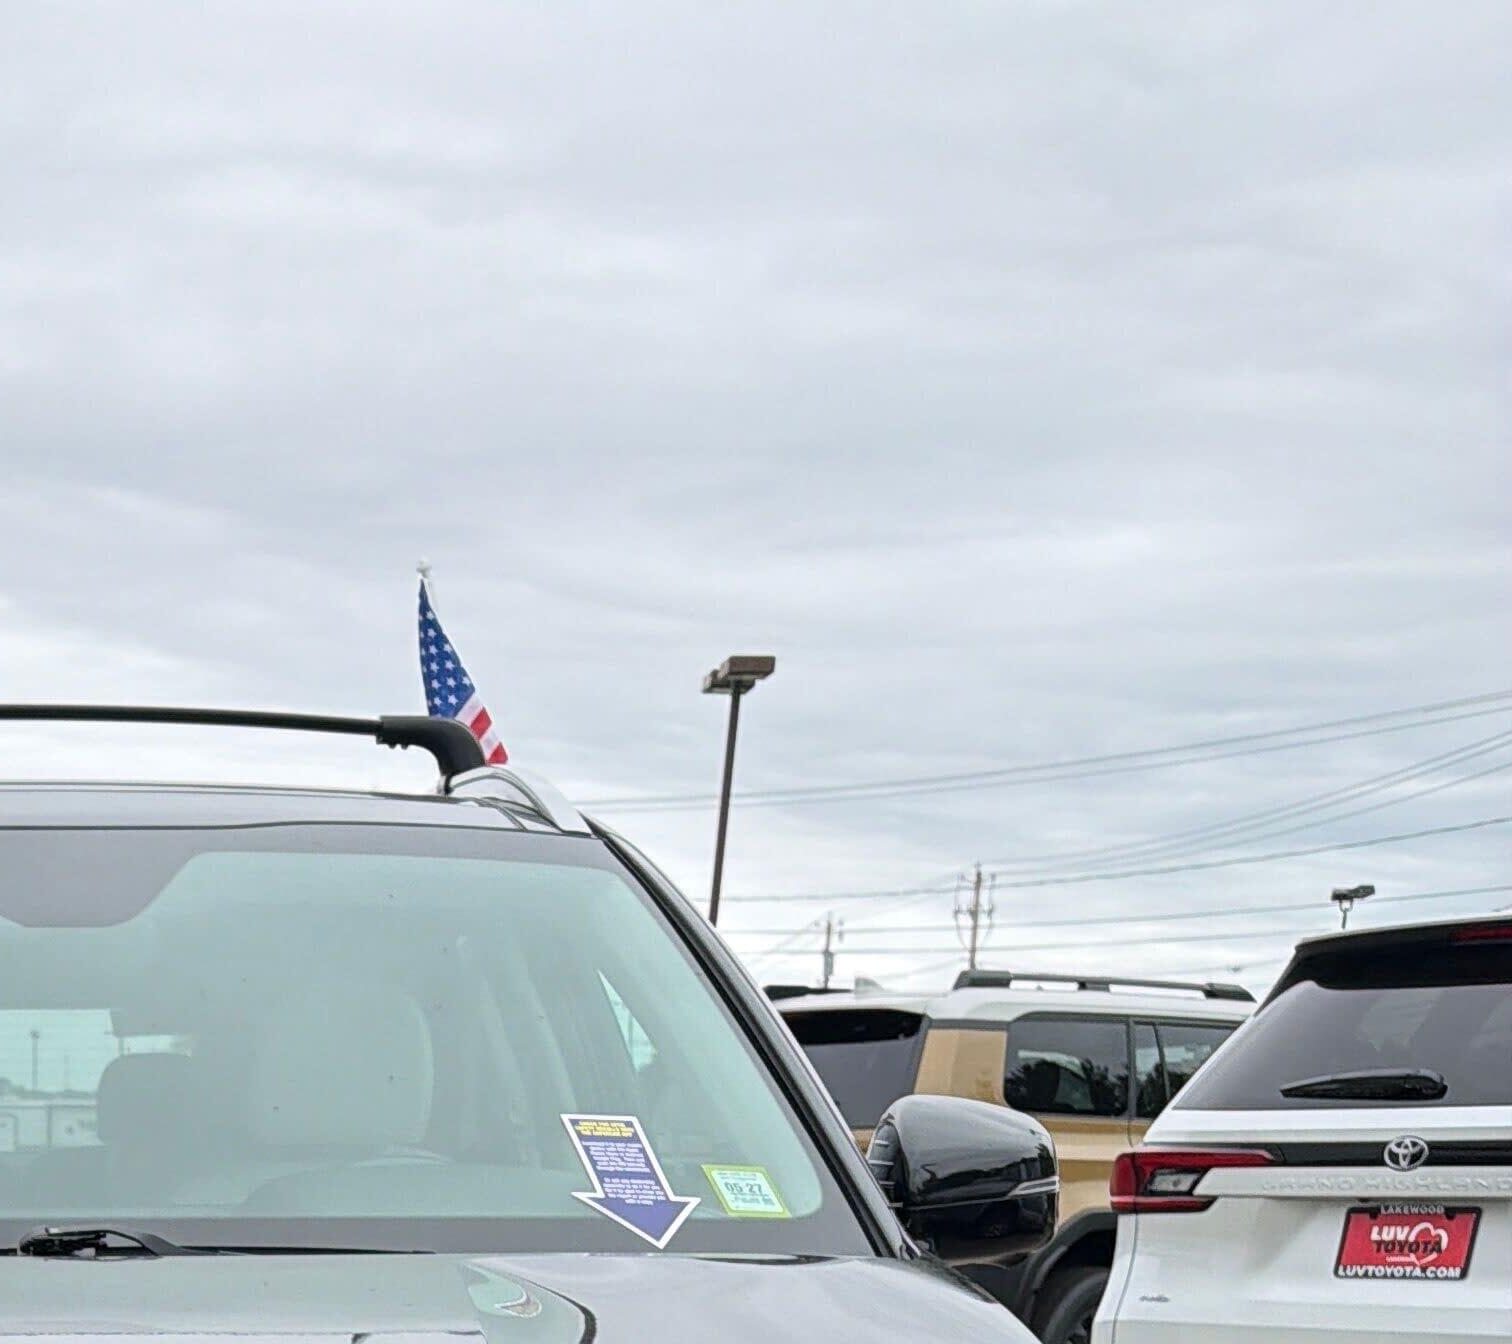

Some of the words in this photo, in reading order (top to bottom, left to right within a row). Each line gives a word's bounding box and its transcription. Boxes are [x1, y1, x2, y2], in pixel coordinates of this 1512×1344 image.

[1380, 1205, 1445, 1214] LAKEWOOD
[1370, 1225, 1410, 1241] LUV
[1374, 1240, 1443, 1254] TOYOTA
[1337, 1264, 1462, 1278] LUVTOYOTA.COM
